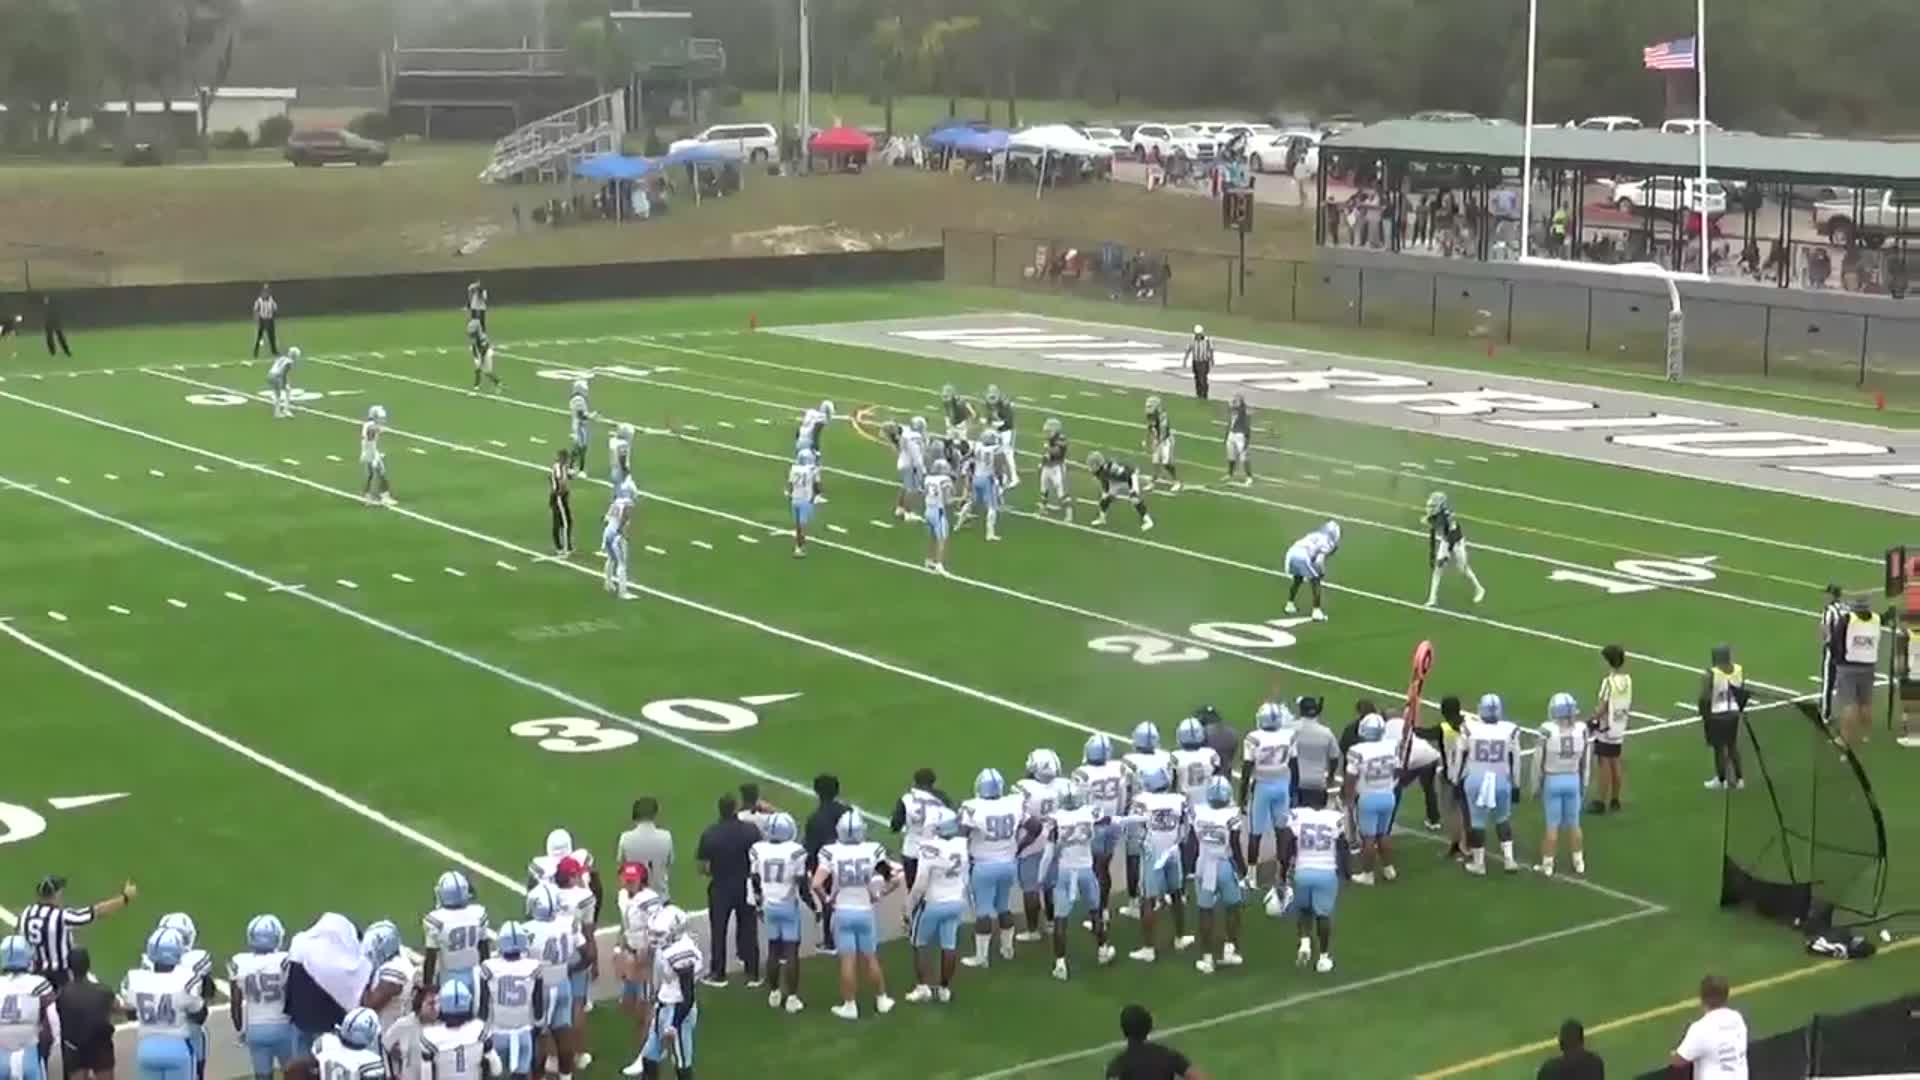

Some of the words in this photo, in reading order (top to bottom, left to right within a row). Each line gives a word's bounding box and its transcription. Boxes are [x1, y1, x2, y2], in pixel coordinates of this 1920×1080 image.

[1551, 560, 1716, 593] 10
[1088, 622, 1297, 664] 20
[510, 698, 758, 752] 30
[1474, 740, 1506, 763] 69
[945, 853, 961, 878] 2
[27, 918, 44, 944] S
[136, 992, 177, 1025] 64
[455, 1044, 466, 1073] 1
